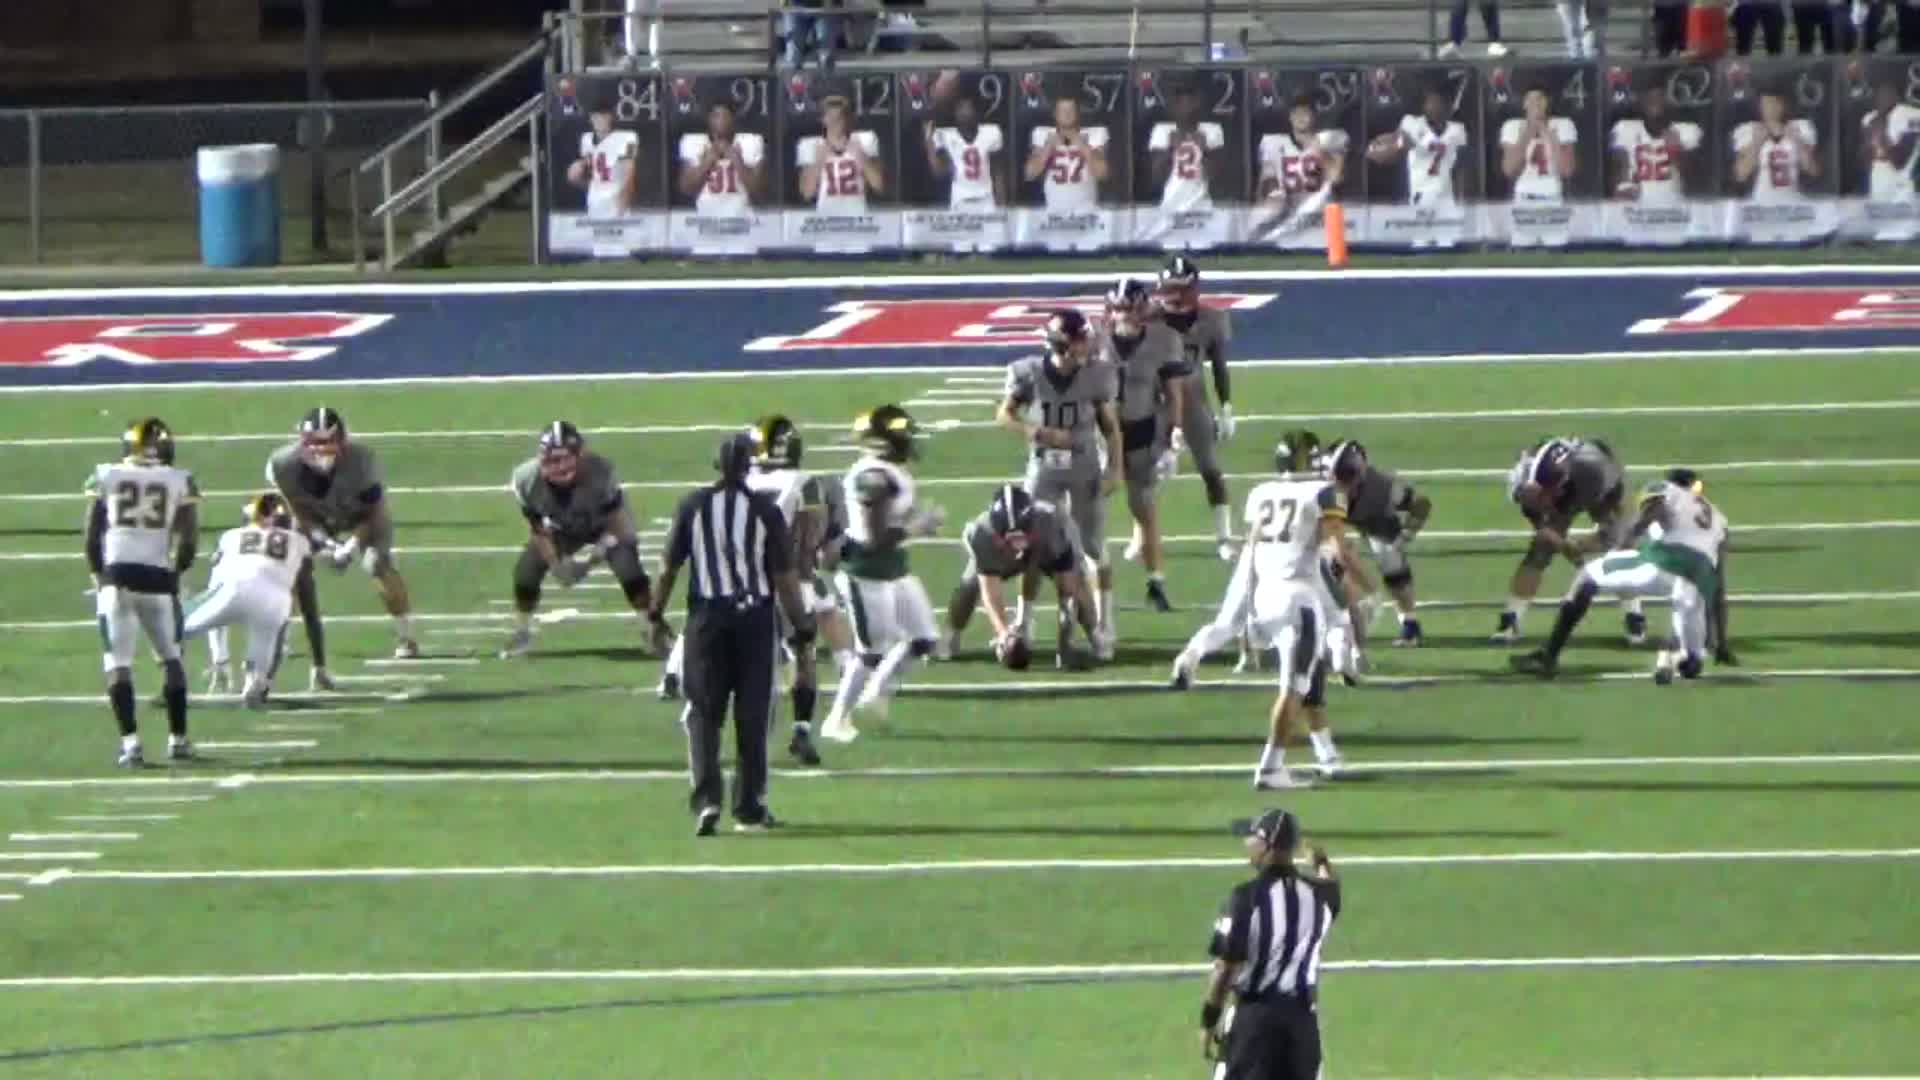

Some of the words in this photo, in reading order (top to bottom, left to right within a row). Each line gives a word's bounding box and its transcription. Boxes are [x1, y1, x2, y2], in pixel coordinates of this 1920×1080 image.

[615, 79, 660, 121] 84
[730, 78, 768, 115] 91
[853, 78, 890, 115] 12
[978, 75, 1003, 114] 9
[1081, 73, 1124, 113] 57
[1211, 72, 1236, 113] 2
[1447, 70, 1470, 110] 7
[1564, 69, 1585, 109] 4
[1667, 67, 1712, 106] 62
[1798, 70, 1825, 106] 6
[824, 158, 860, 196] 12
[961, 145, 982, 181] 9
[1047, 151, 1088, 185] 57
[1176, 141, 1202, 180] 2
[1427, 143, 1449, 177] 7
[1770, 149, 1796, 187] 6
[1041, 401, 1078, 428] 10
[116, 480, 169, 528] 23
[1258, 498, 1298, 543] 27
[239, 529, 289, 560] 28
